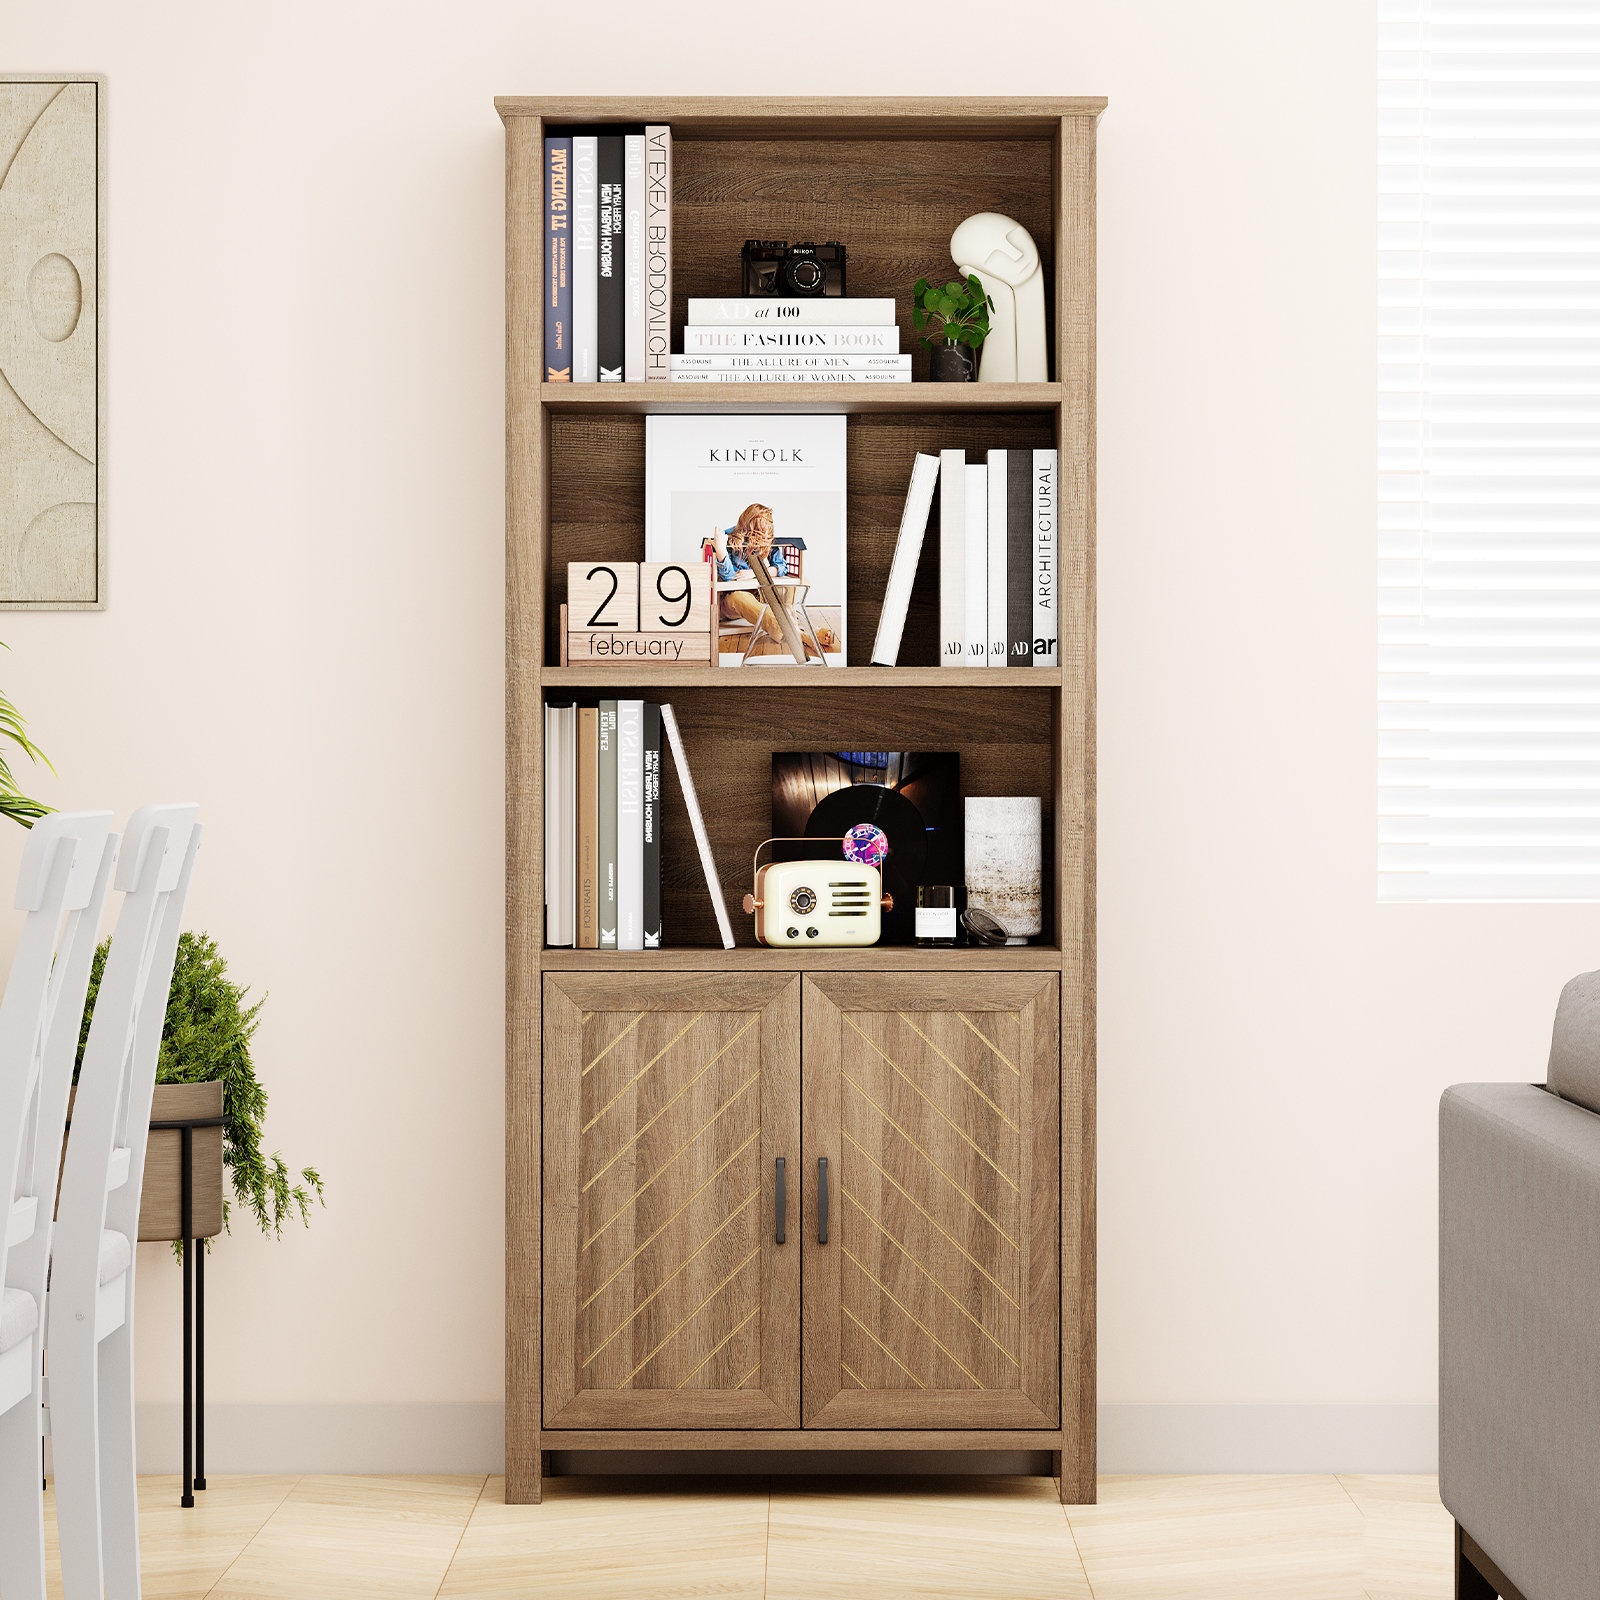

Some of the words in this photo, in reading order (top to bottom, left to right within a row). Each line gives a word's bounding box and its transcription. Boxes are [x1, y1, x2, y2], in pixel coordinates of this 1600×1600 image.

[754, 305, 770, 318] at
[776, 306, 800, 318] 100
[695, 334, 737, 346] THE
[743, 334, 827, 346] FASHION
[834, 334, 885, 346] BOOK
[730, 358, 754, 367] THE
[756, 358, 803, 367] ALLURE
[804, 358, 820, 367] OF
[823, 358, 850, 367] MEN
[717, 374, 741, 382] THE
[742, 374, 790, 382] ALLURE
[792, 374, 808, 382] OF
[810, 374, 856, 382] WOMEN
[709, 448, 803, 462] KINFOLK
[1038, 462, 1052, 609] ARCHITECTURAL
[588, 633, 684, 662] february
[944, 641, 962, 655] AD
[967, 643, 984, 656] AD
[990, 641, 1005, 655] AD
[1010, 641, 1029, 656] AD
[1033, 638, 1057, 655] ar
[583, 877, 591, 928] PORTRAITS
